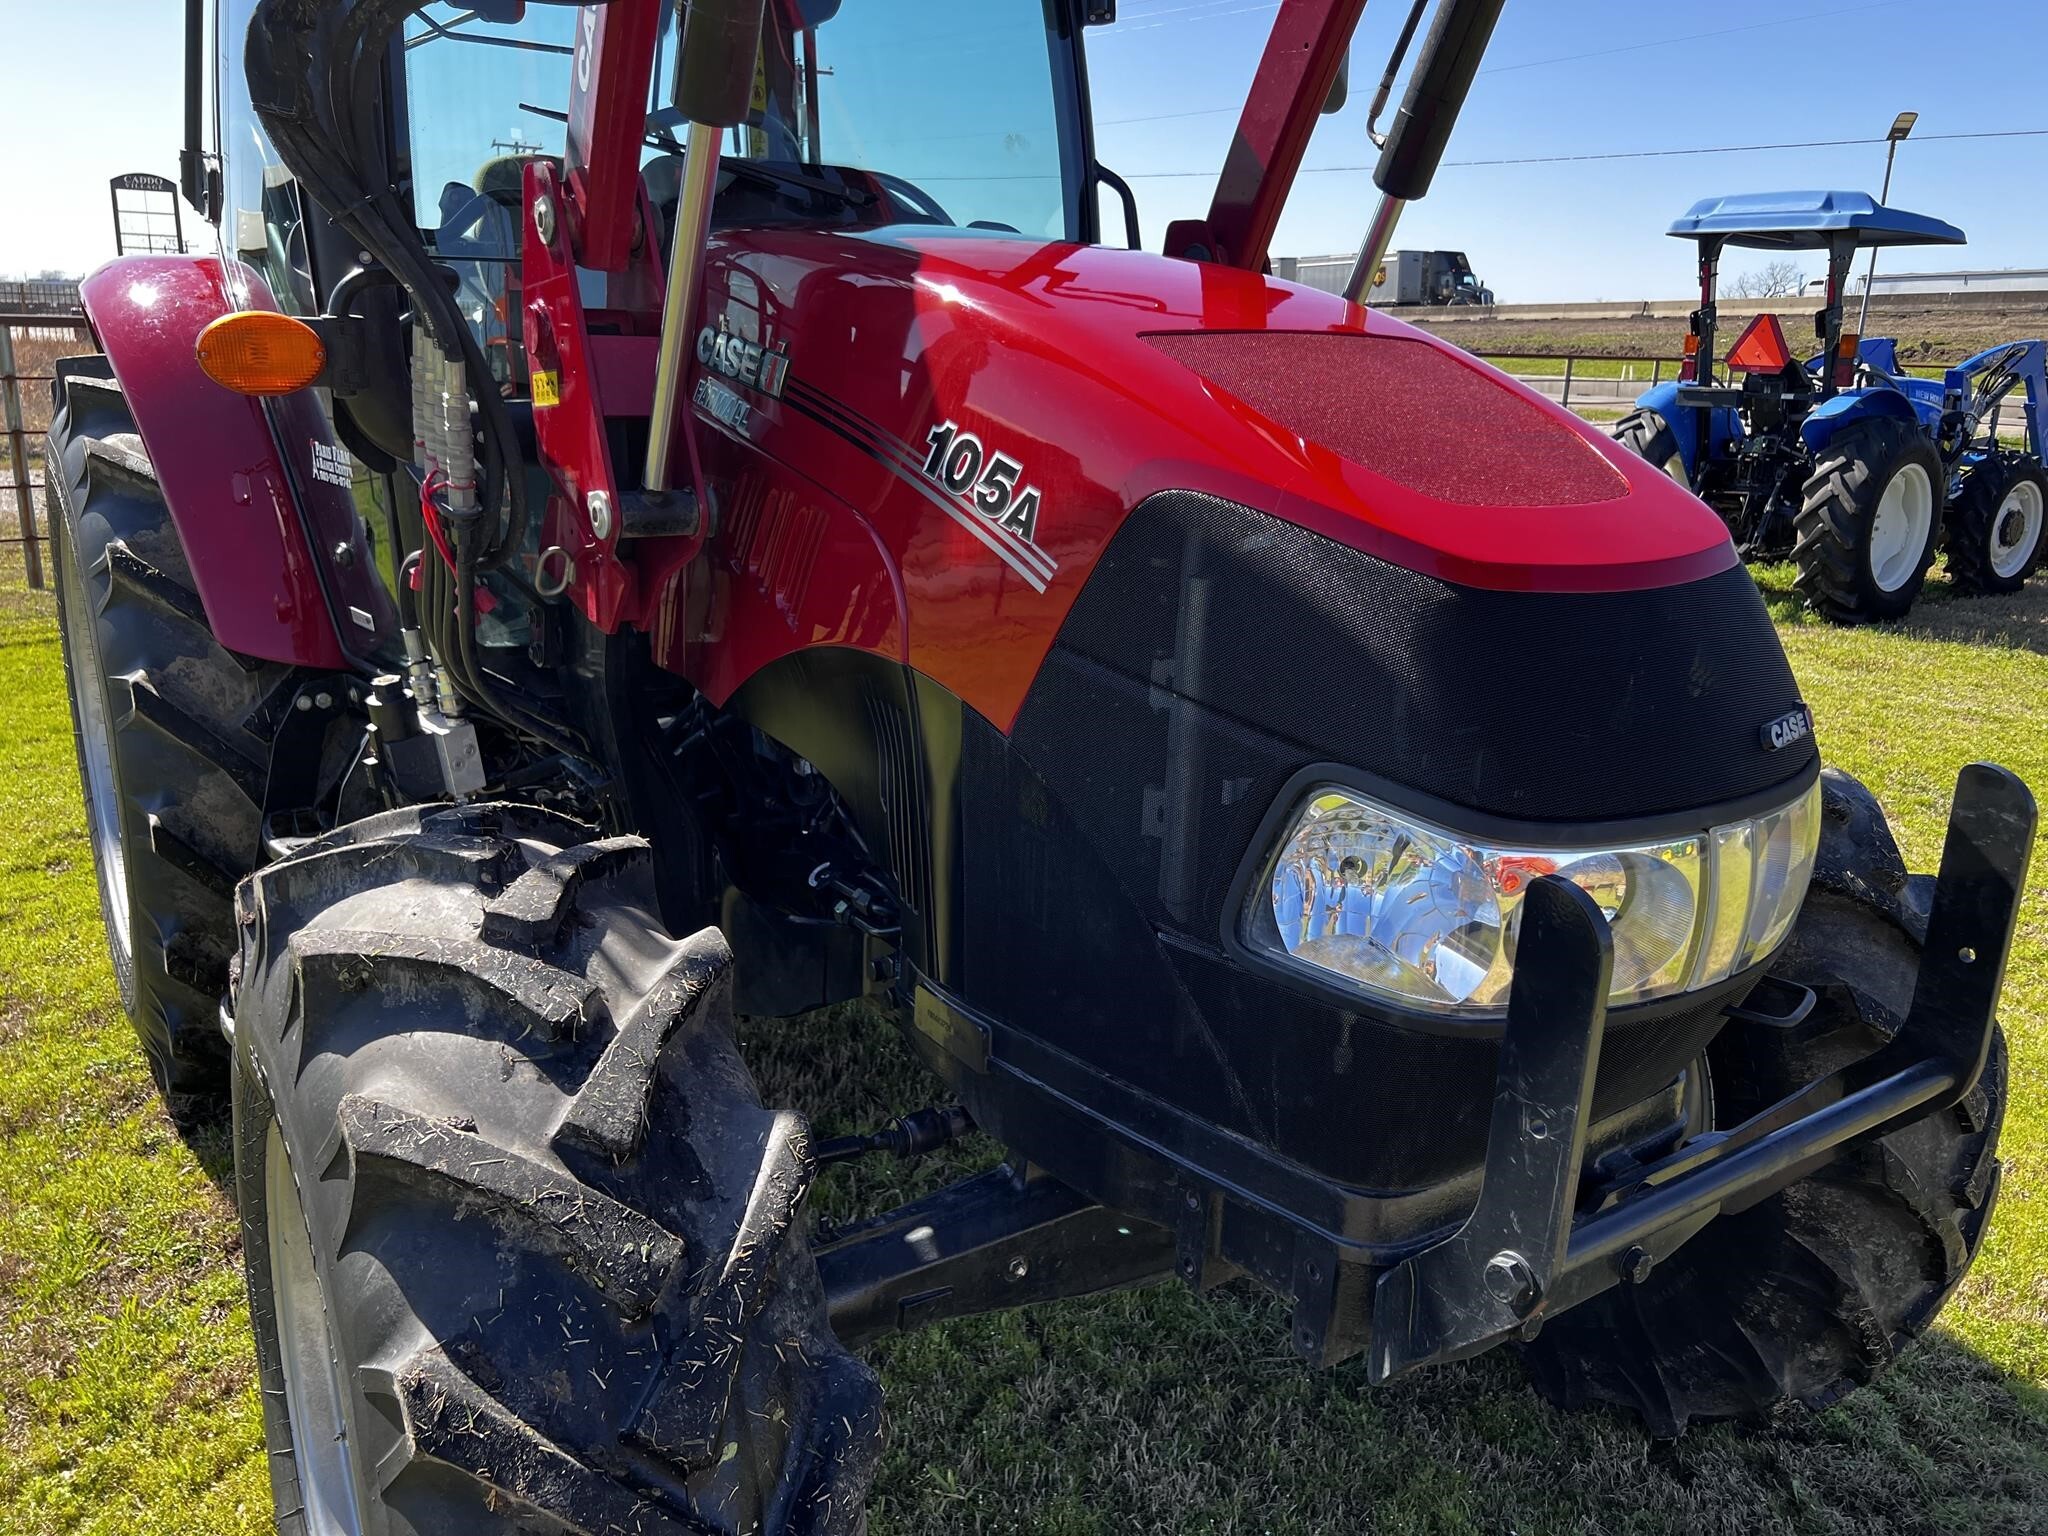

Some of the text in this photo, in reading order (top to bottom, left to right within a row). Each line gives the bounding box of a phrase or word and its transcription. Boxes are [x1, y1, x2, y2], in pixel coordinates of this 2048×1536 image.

[123, 175, 163, 186] CADDO
[124, 182, 162, 191] VILLAGE
[697, 325, 763, 386] CASE
[922, 418, 1041, 545] 105A
[1771, 712, 1807, 748] CASE
